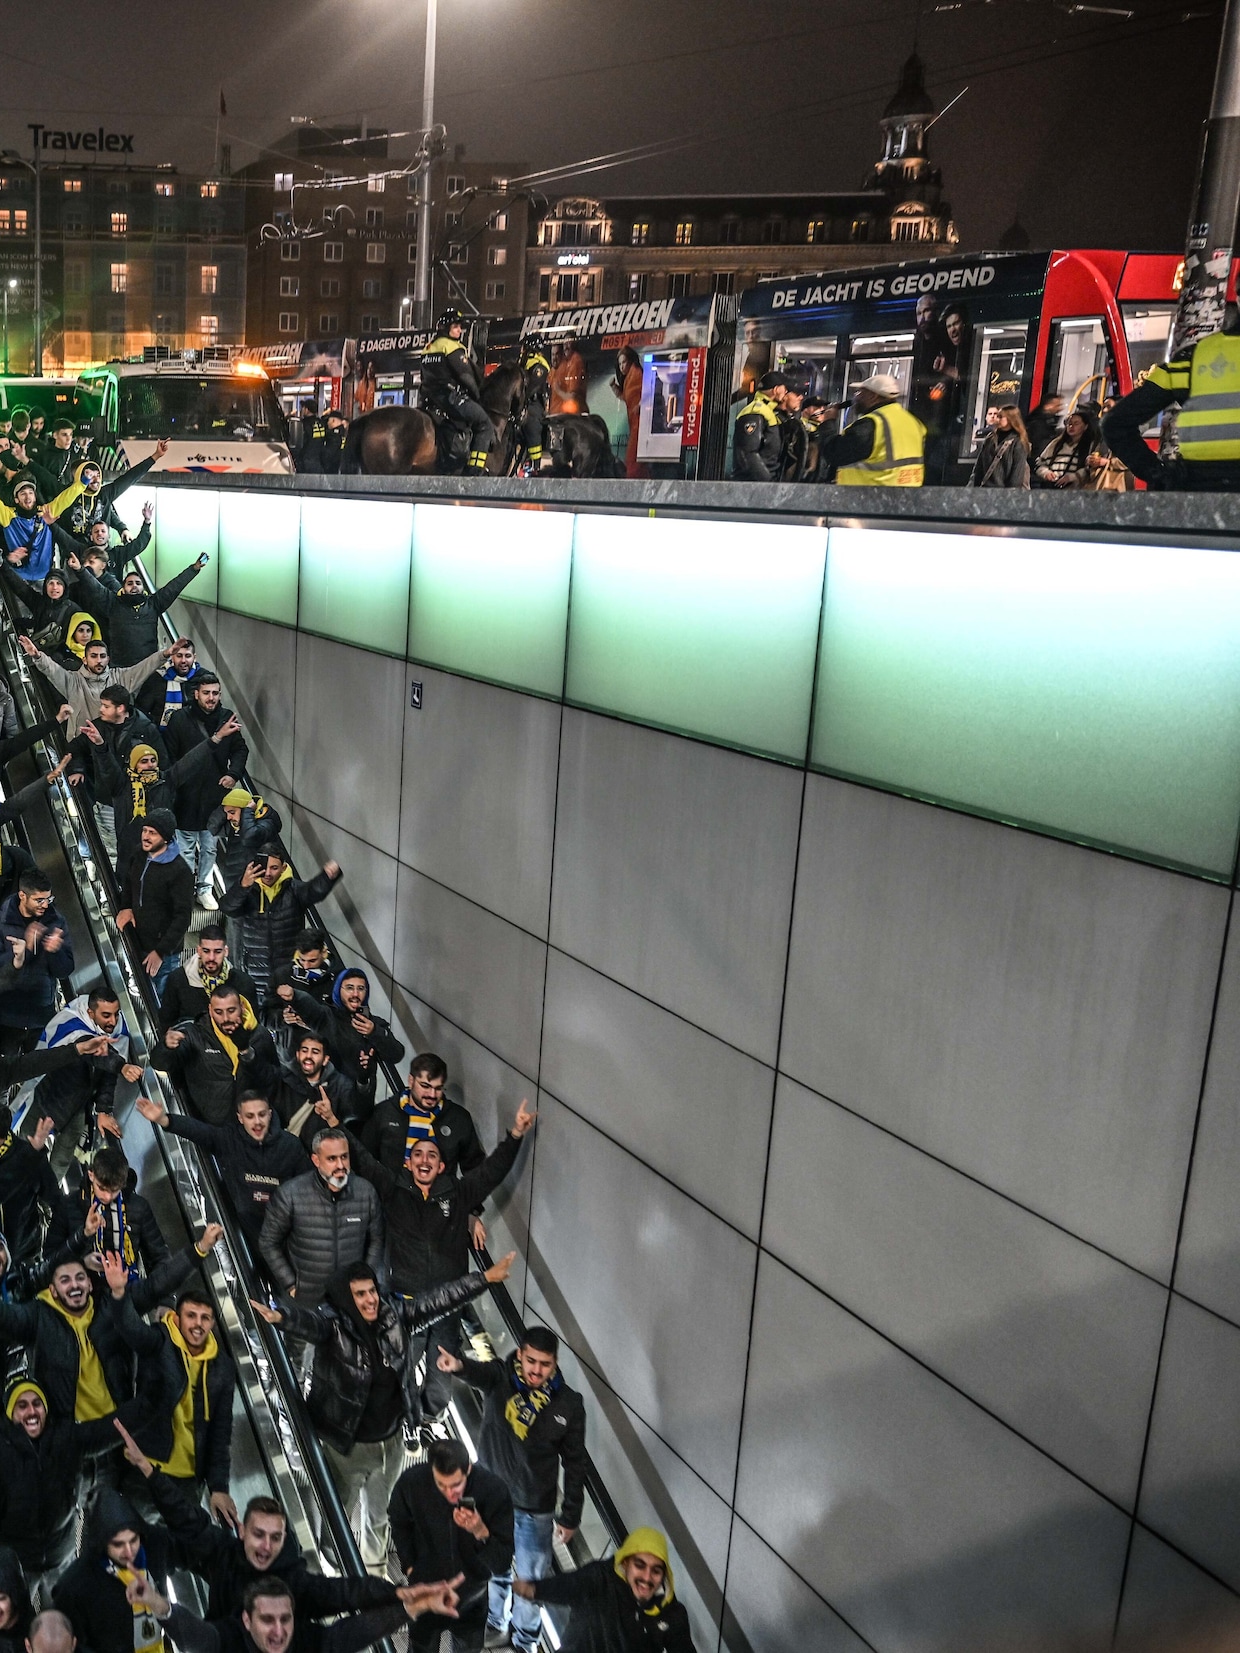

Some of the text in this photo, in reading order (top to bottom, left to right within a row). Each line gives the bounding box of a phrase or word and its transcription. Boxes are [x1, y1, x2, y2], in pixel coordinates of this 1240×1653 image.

[27, 124, 134, 153] Travelex
[772, 266, 995, 308] DE JACHT IS GEOPEND
[360, 341, 366, 353] 5
[367, 337, 397, 352] DAGEN
[398, 335, 411, 349] OP
[412, 333, 426, 347] DE
